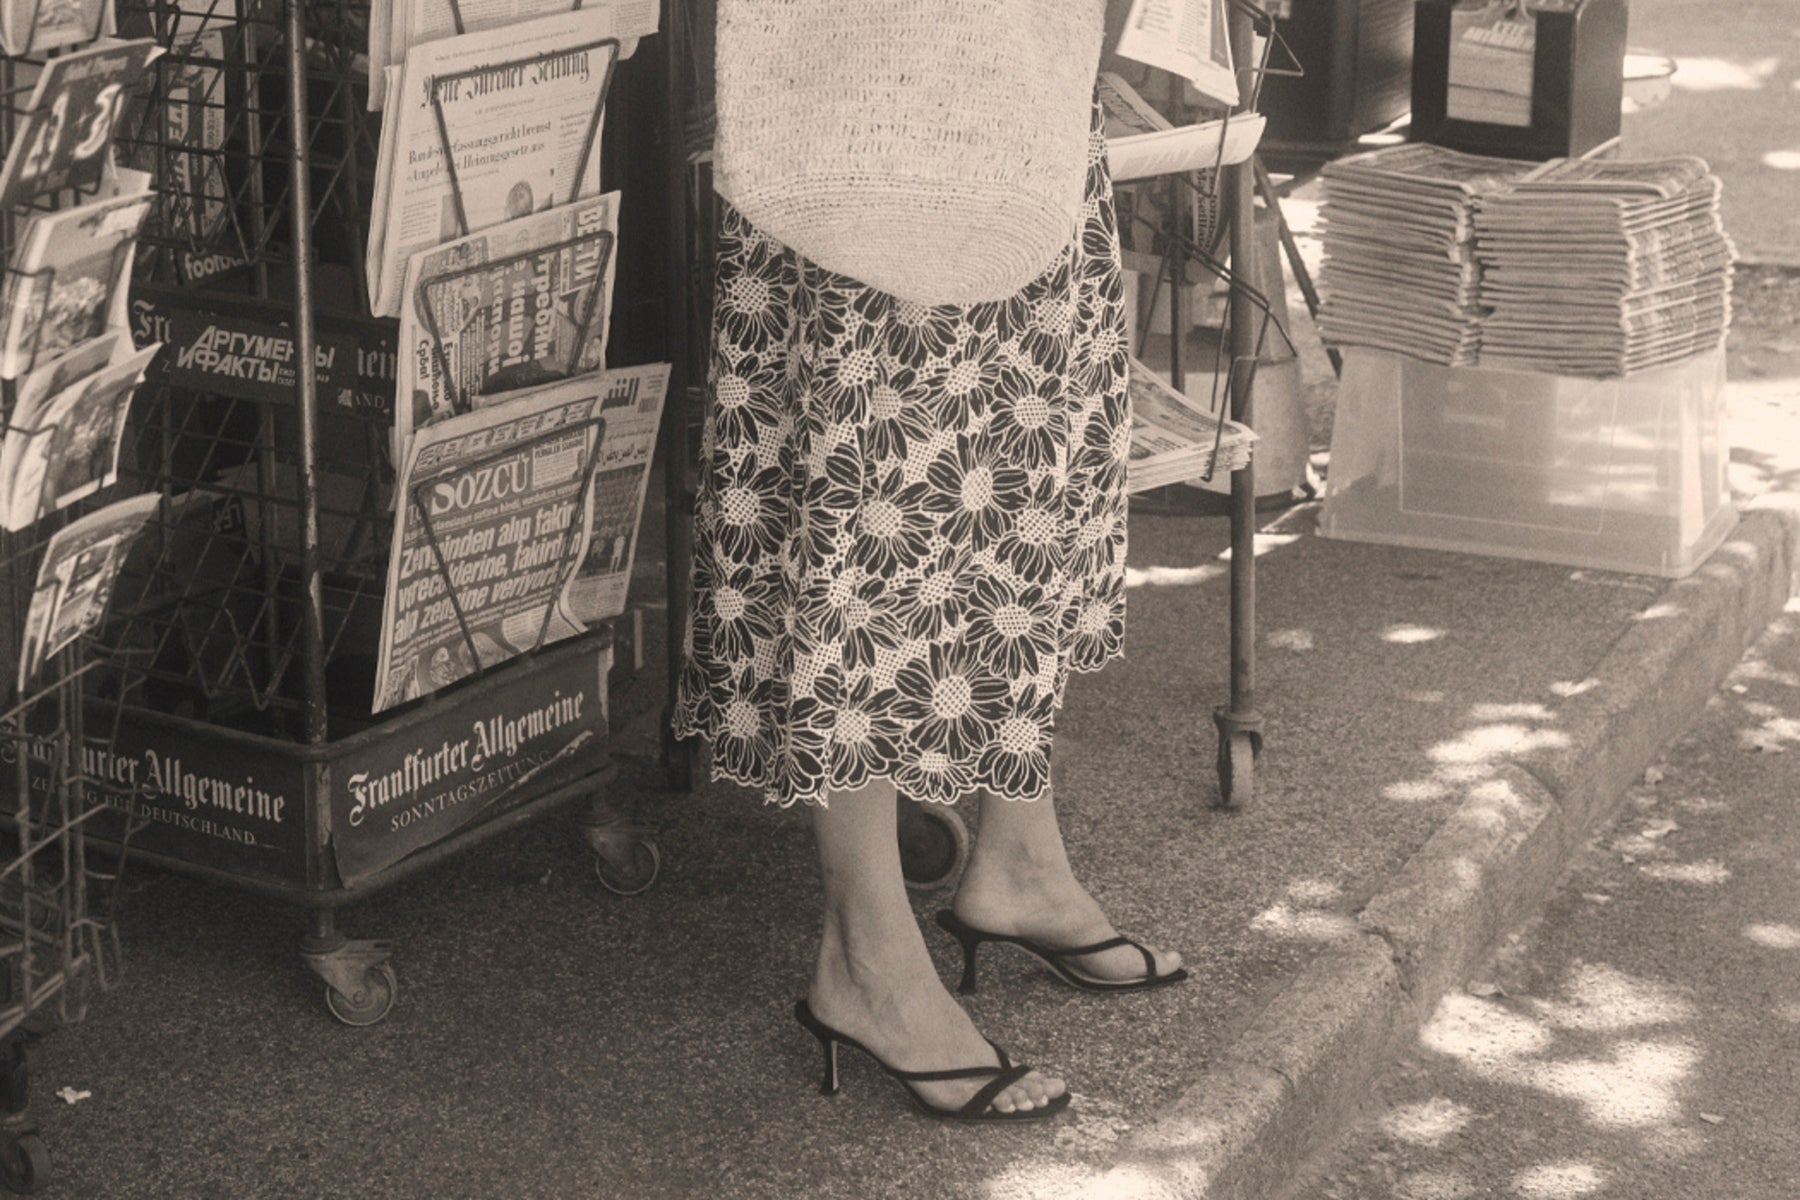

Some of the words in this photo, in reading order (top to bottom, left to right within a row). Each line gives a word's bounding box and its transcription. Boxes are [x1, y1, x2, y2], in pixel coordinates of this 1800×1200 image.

[142, 749, 286, 824] Allgemeine
[347, 736, 471, 827] Frankfurter
[471, 690, 584, 773] Allgemeine
[390, 749, 551, 833] SONNTAGSZEITUNG
